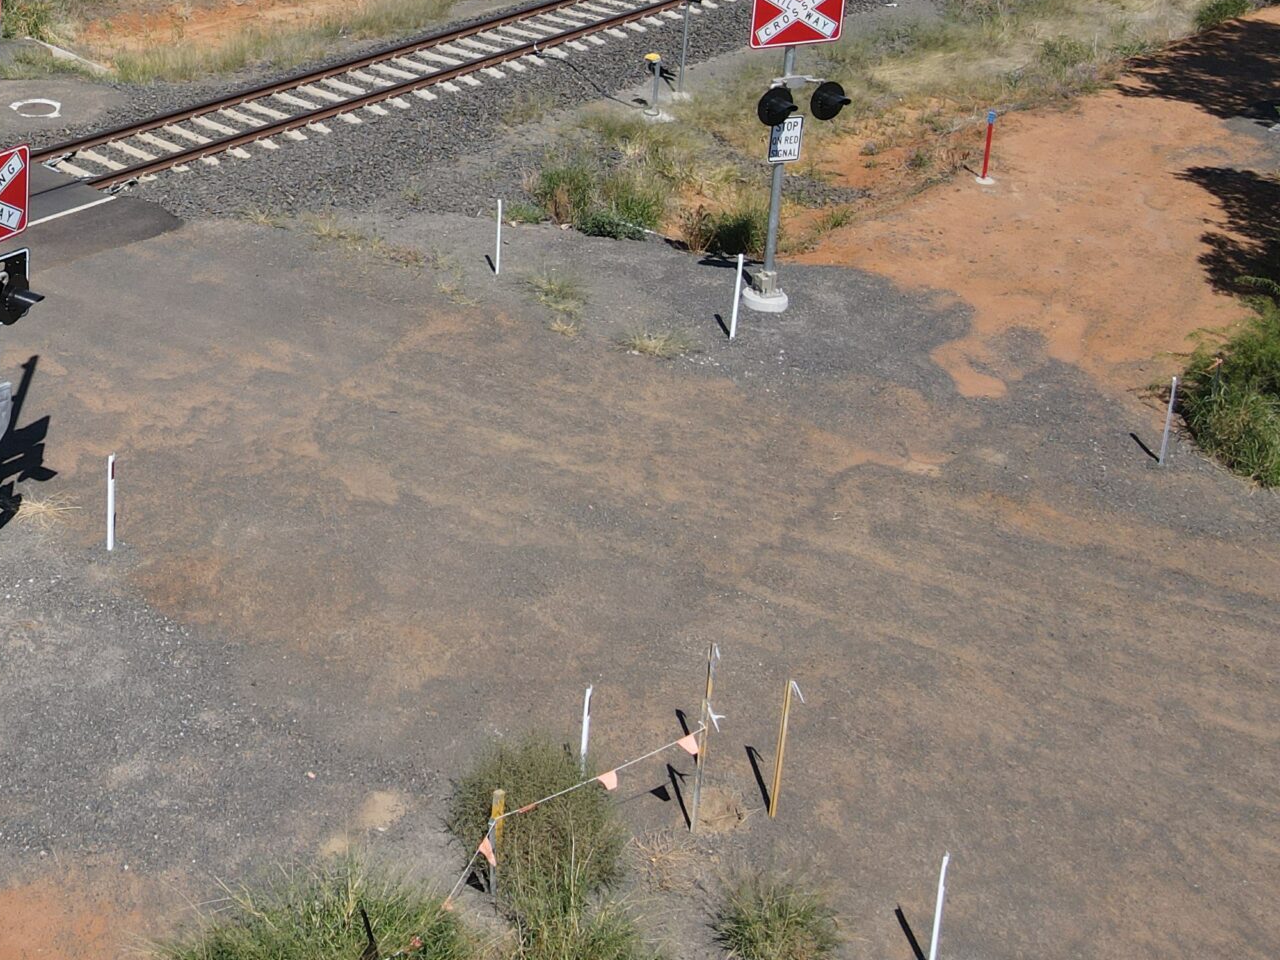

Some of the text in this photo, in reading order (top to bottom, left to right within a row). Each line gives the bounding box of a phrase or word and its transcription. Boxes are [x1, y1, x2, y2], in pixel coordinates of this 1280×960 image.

[776, 121, 799, 132] STOP
[772, 135, 799, 145] ON RED
[771, 148, 797, 157] SIGNAL
